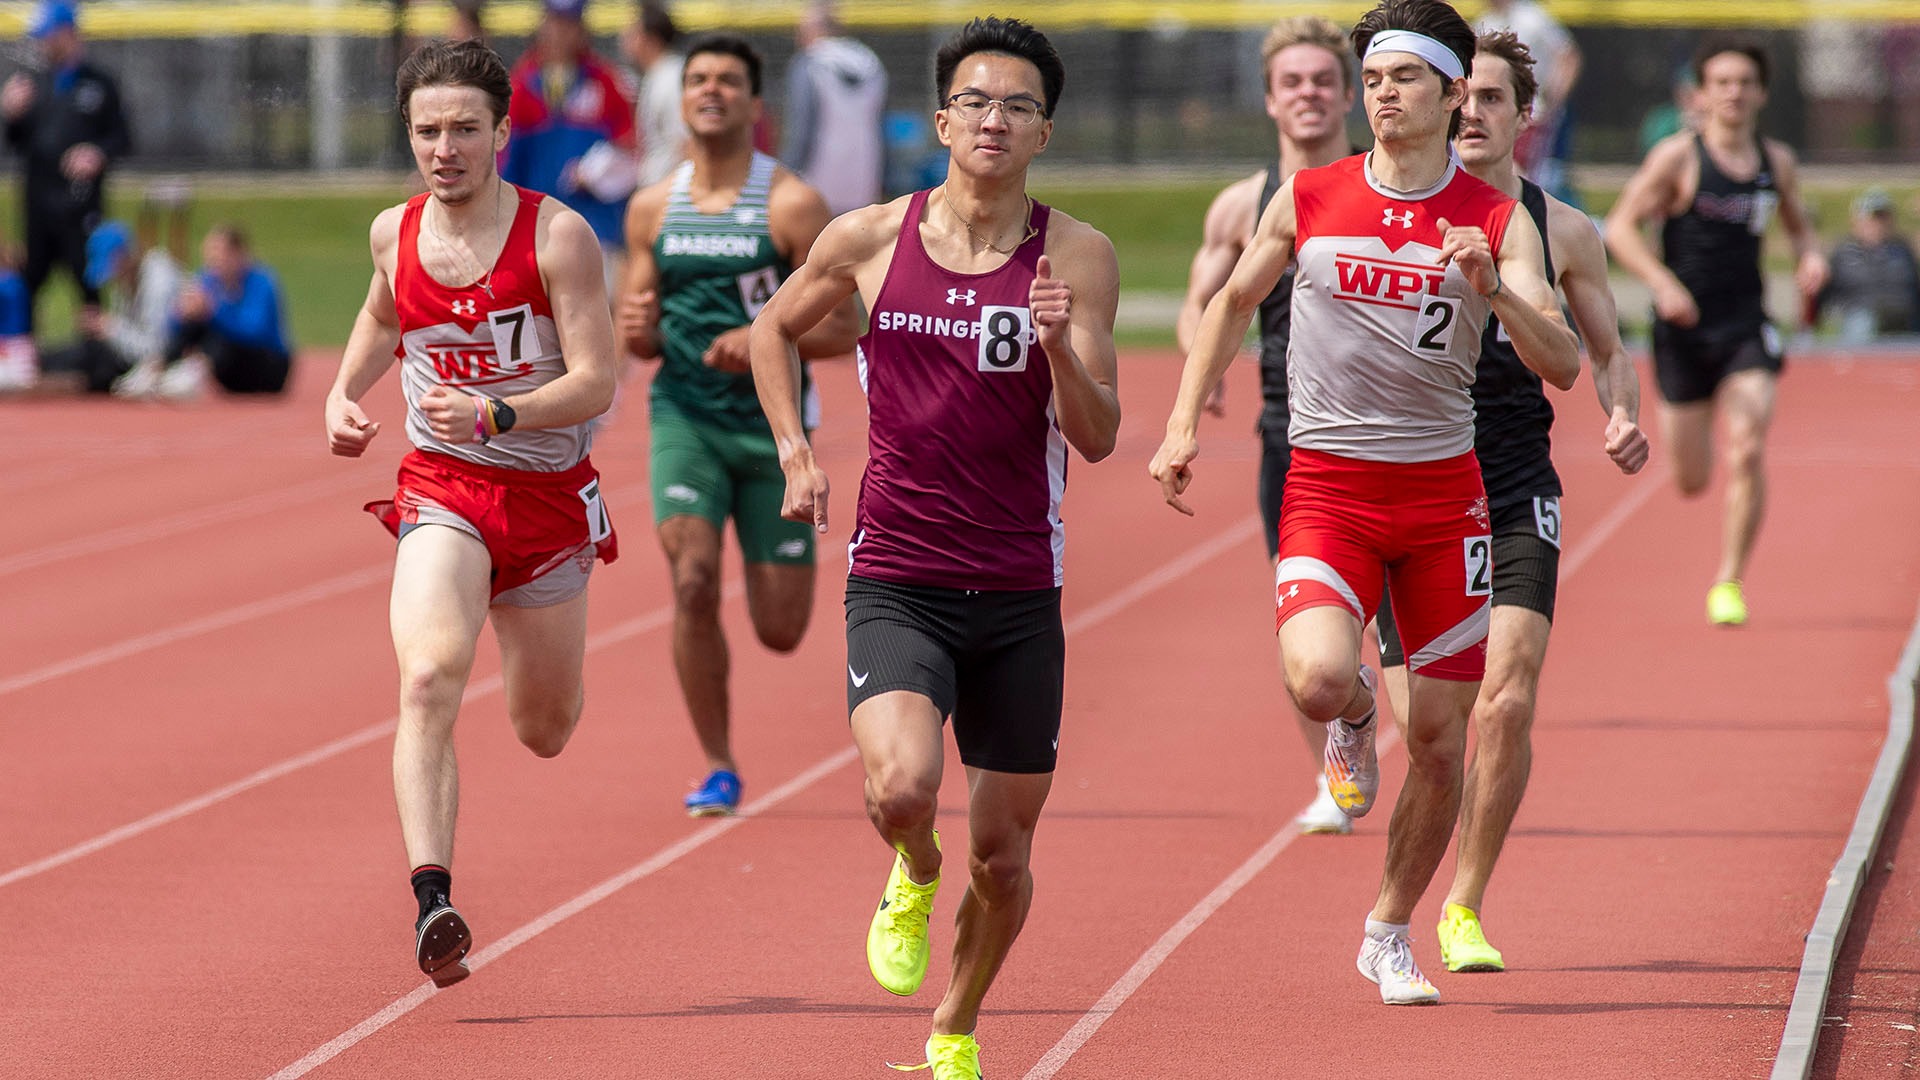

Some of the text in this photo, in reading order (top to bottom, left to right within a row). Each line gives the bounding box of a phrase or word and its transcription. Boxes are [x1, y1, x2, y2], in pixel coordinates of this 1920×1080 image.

[1334, 260, 1445, 301] WPI
[494, 310, 525, 362] 7
[878, 311, 1037, 345] SPRINGFD
[985, 311, 1021, 368] 8
[1417, 301, 1454, 351] 2
[428, 349, 533, 380] WP
[1539, 496, 1559, 541] 5
[1470, 540, 1490, 592] 2
